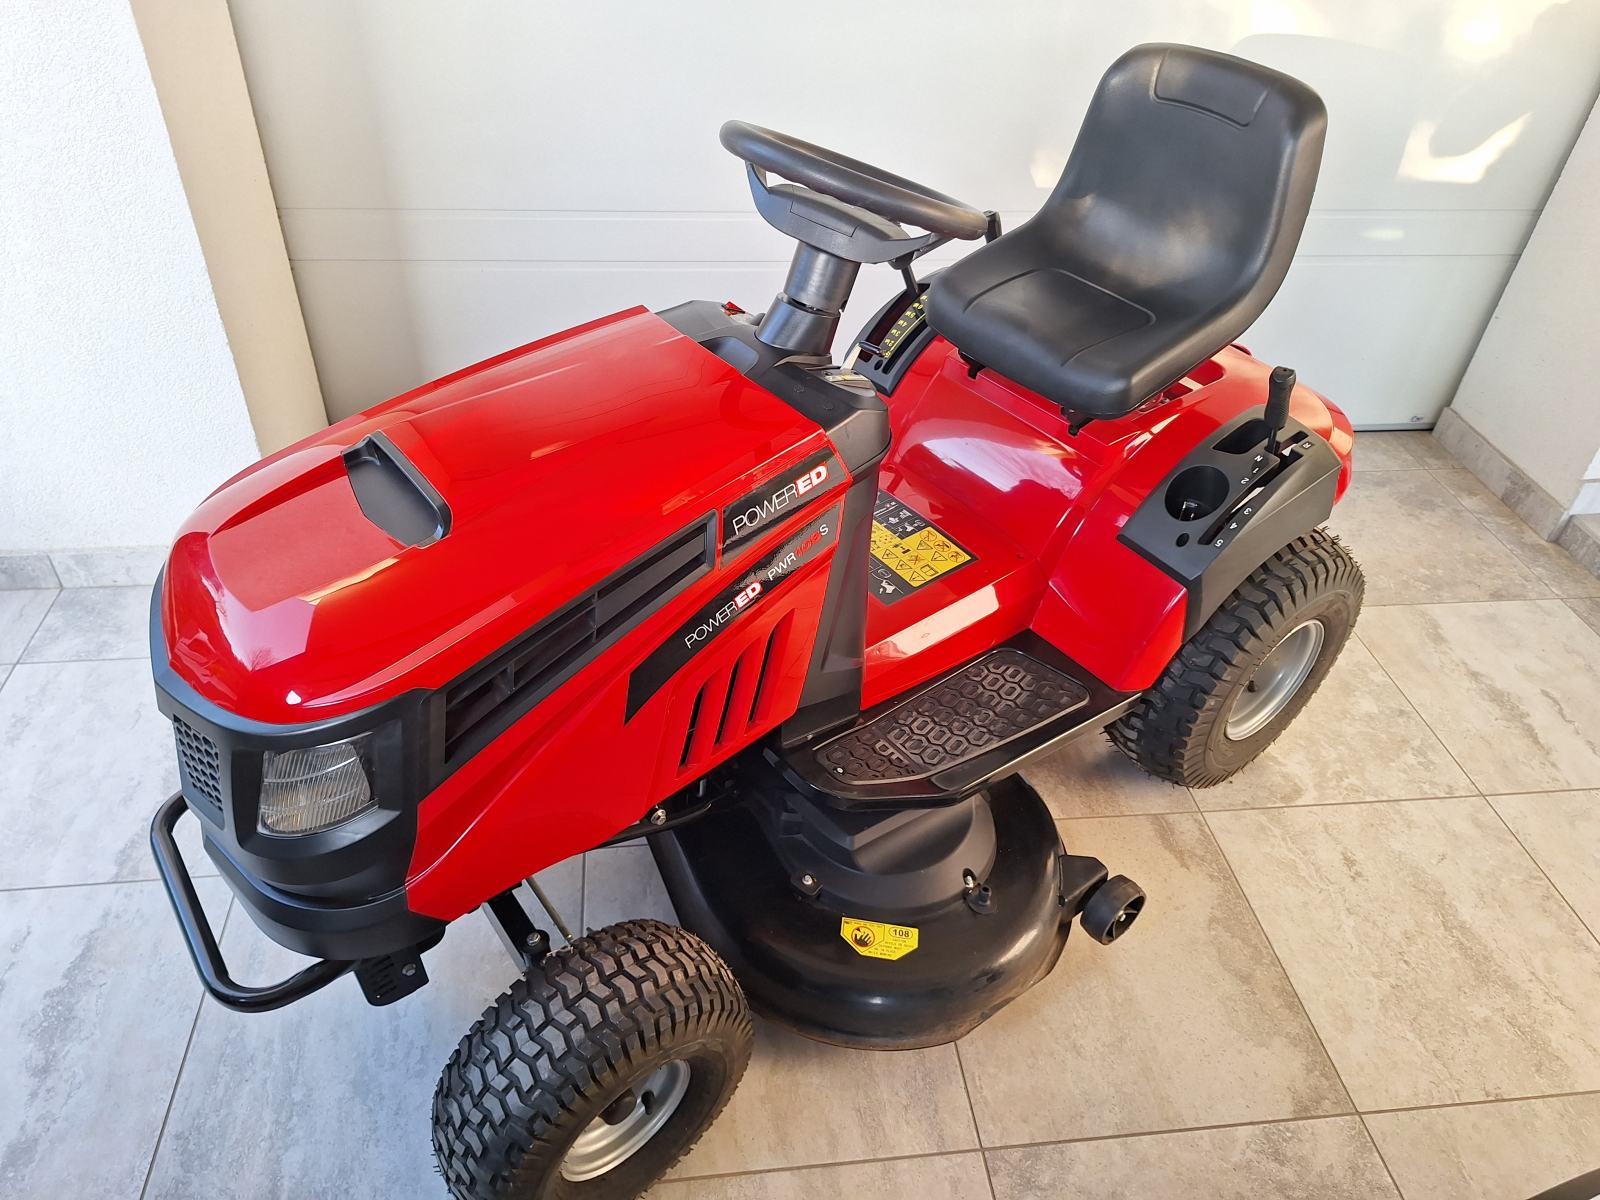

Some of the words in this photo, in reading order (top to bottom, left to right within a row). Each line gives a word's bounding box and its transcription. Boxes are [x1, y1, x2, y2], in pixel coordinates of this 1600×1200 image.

[1254, 454, 1263, 462] N
[732, 464, 828, 535] POWERED
[1243, 507, 1252, 515] 3
[1214, 539, 1224, 547] 5
[684, 580, 763, 649] POWERED
[893, 928, 910, 938] 108
